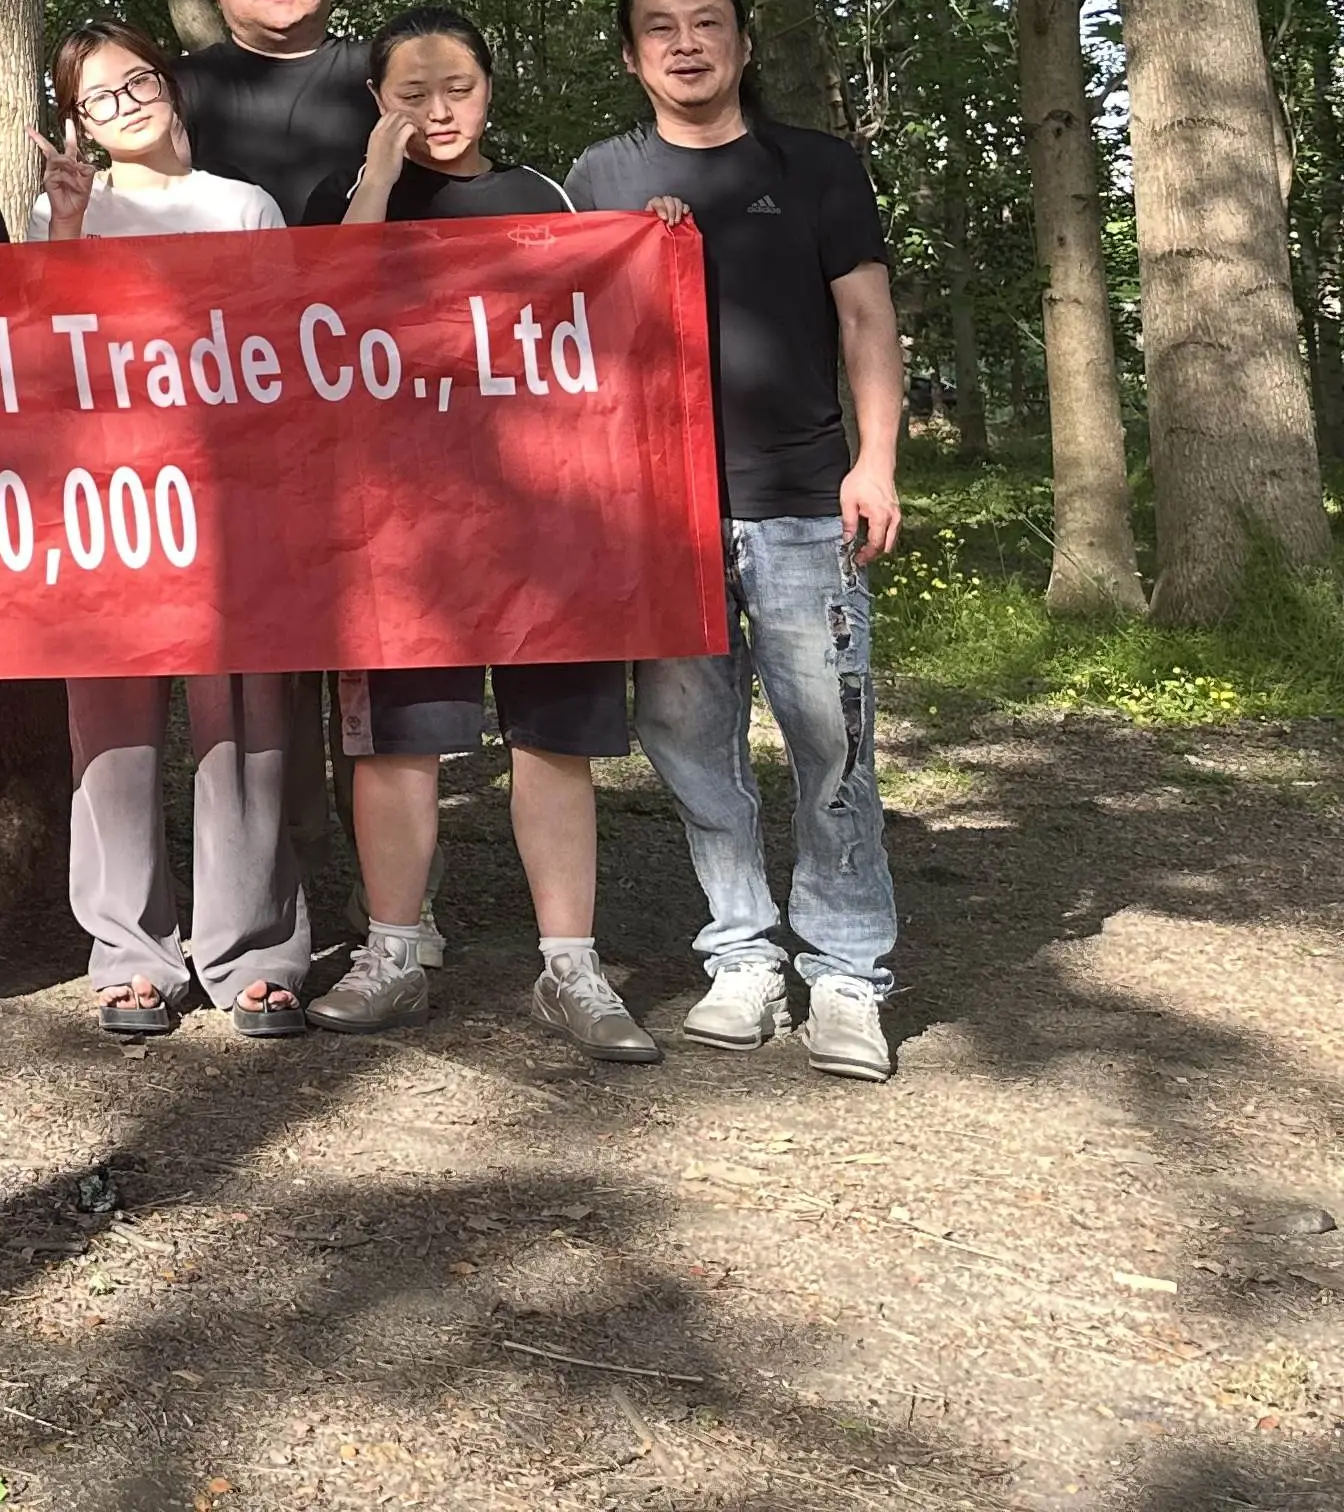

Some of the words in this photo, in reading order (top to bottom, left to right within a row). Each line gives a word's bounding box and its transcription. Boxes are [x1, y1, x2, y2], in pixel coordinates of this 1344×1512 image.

[52, 310, 282, 409] Trade
[300, 304, 452, 413] Co.,
[469, 292, 599, 396] Ltd
